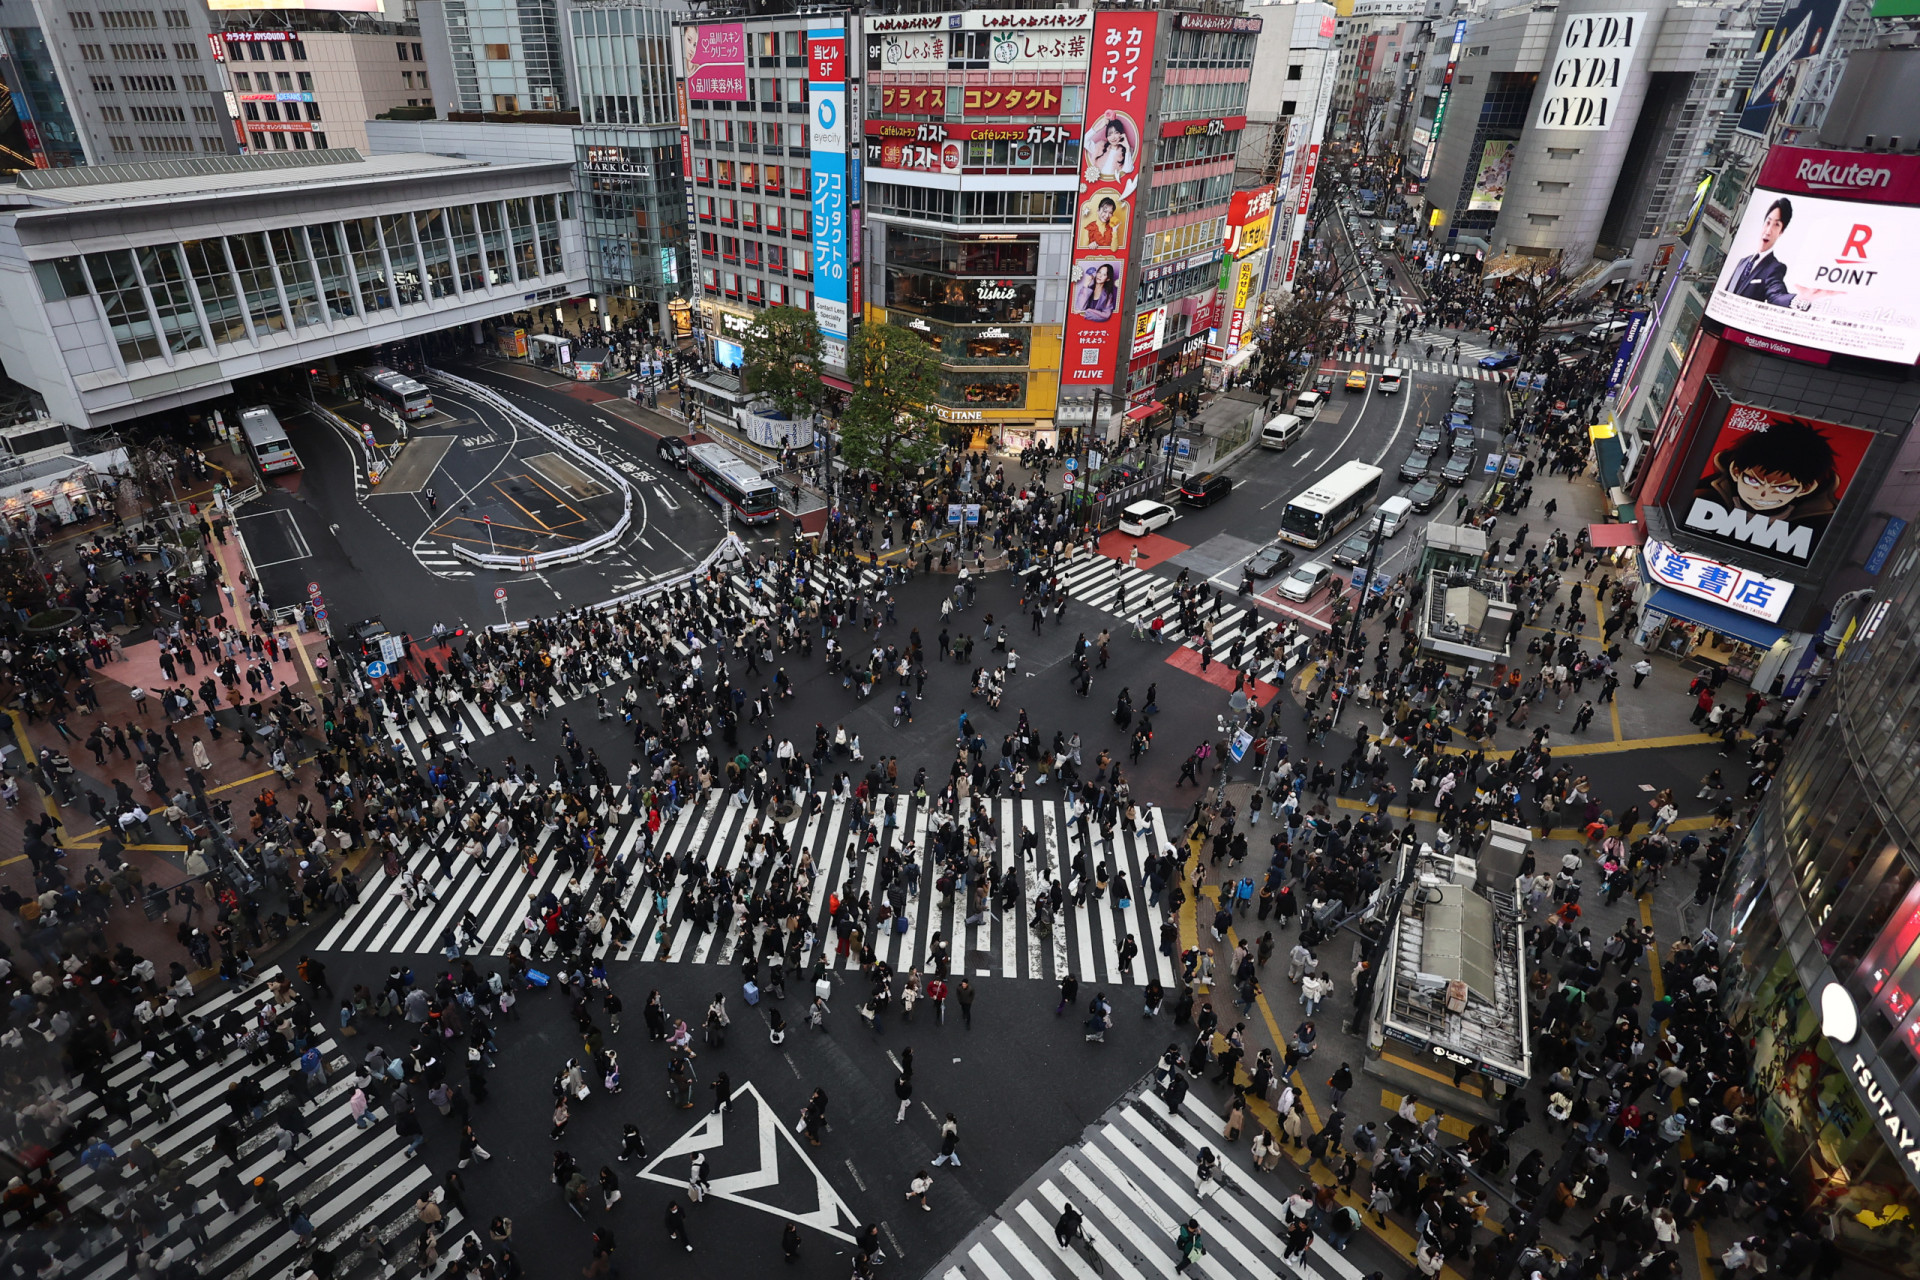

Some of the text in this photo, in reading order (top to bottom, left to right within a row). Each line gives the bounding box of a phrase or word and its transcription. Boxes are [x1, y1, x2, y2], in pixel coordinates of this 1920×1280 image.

[872, 16, 943, 31] しゃぶしゃぶバイキング
[982, 14, 1088, 27] しゃぶしゃぶバイキング
[226, 33, 252, 41] カラオケ
[709, 31, 741, 44] 品川スキン
[1566, 17, 1634, 48] GYDA
[710, 46, 738, 58] クリニック
[814, 45, 839, 60] 当ビル
[869, 45, 880, 59] 9F
[904, 38, 944, 59] しゃぶ葉
[1024, 35, 1086, 59] しゃぶ葉
[820, 62, 833, 77] 5F
[1101, 28, 1122, 93] みっけ。
[1120, 27, 1143, 102] カワイイ
[1554, 58, 1621, 88] GYDA
[696, 78, 743, 93] 品川美容外科
[883, 89, 944, 108] プライス
[964, 89, 1058, 109] コンタクト
[1543, 97, 1608, 126] GYDA
[880, 125, 948, 142] Caféレストラン ガスト
[970, 126, 1070, 144] Caféレストラン ガスト
[1207, 120, 1225, 136] ガスト
[814, 133, 841, 144] eyecity
[868, 145, 881, 159] 7F
[901, 145, 939, 168] ガスト
[583, 162, 650, 173] MARK CITY
[1795, 158, 1891, 187] Rakuten
[1300, 172, 1313, 209] TaxFree
[814, 171, 830, 277] アイシティ
[831, 173, 843, 280] コンタクトの
[1841, 223, 1873, 258] R
[1815, 266, 1878, 286] POINT
[977, 287, 1016, 300] Ushi8
[816, 302, 846, 315] Contact Lens
[1196, 307, 1211, 321] アコム
[825, 320, 837, 329] Store
[1183, 335, 1206, 355] LUSH
[1744, 336, 1791, 354] Rakuten Vision
[1073, 370, 1104, 379] 17LIVE
[1684, 497, 1814, 560] DMM
[1852, 1053, 1920, 1173] TSUTAYA
